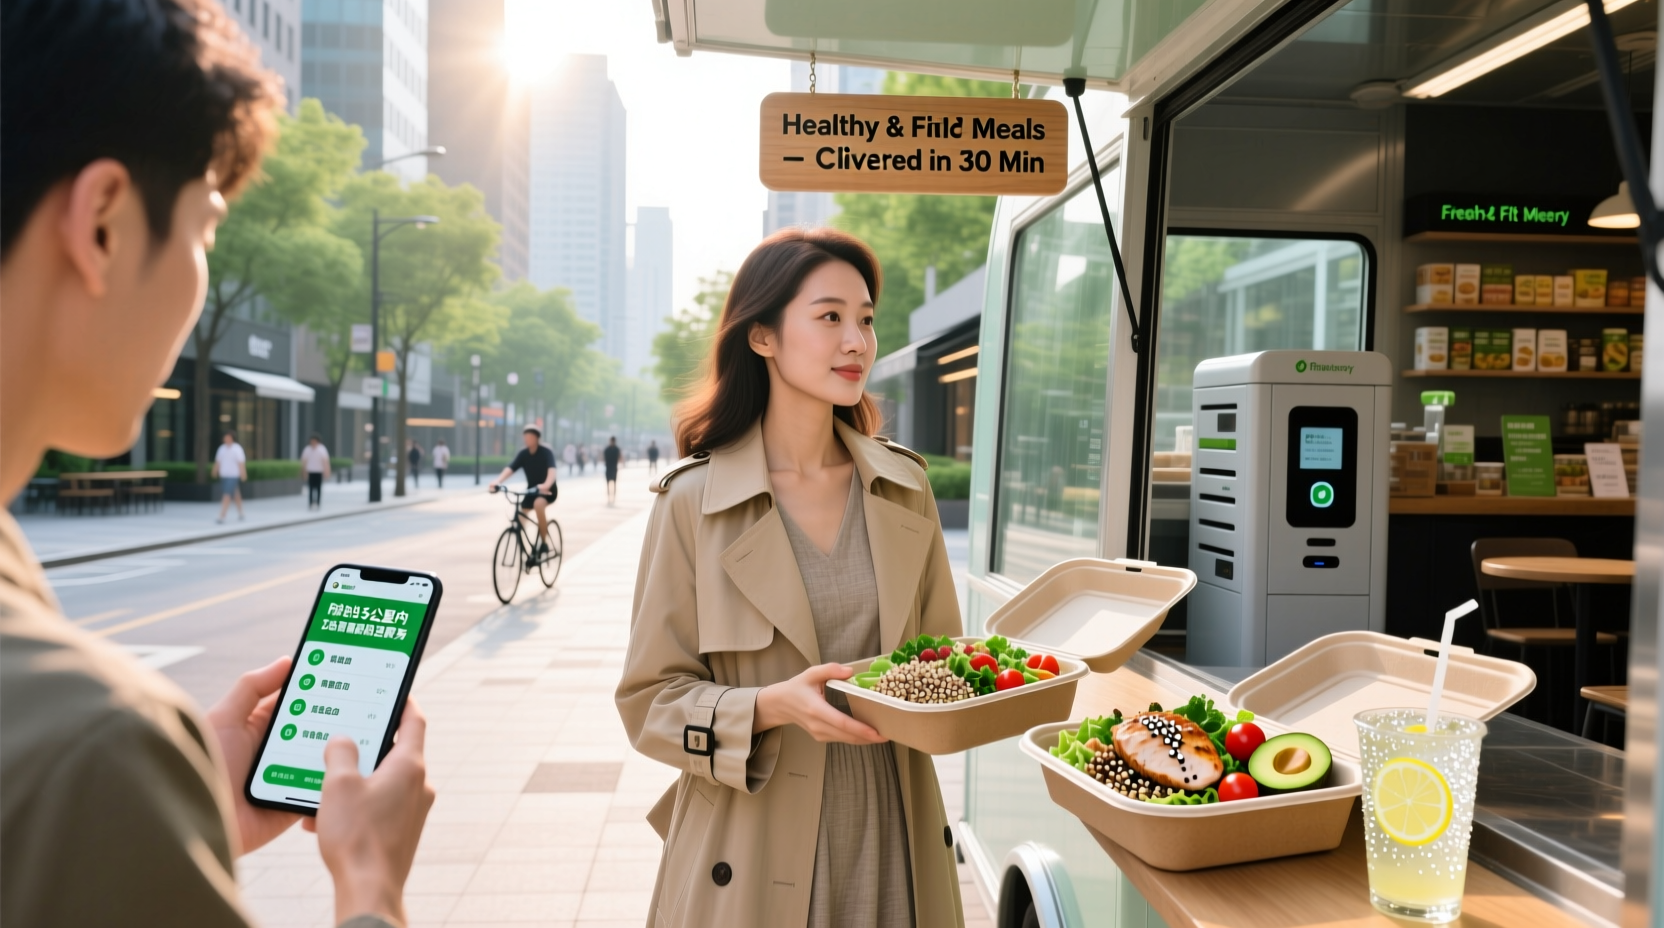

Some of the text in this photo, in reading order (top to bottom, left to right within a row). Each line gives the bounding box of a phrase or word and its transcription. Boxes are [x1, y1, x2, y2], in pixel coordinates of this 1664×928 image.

[783, 113, 880, 143] Healthy
[885, 115, 905, 138] &
[971, 117, 1046, 141] Meals
[815, 146, 922, 171] Clivered
[929, 148, 952, 172] in
[958, 149, 992, 173] 30
[999, 149, 1046, 174] Min
